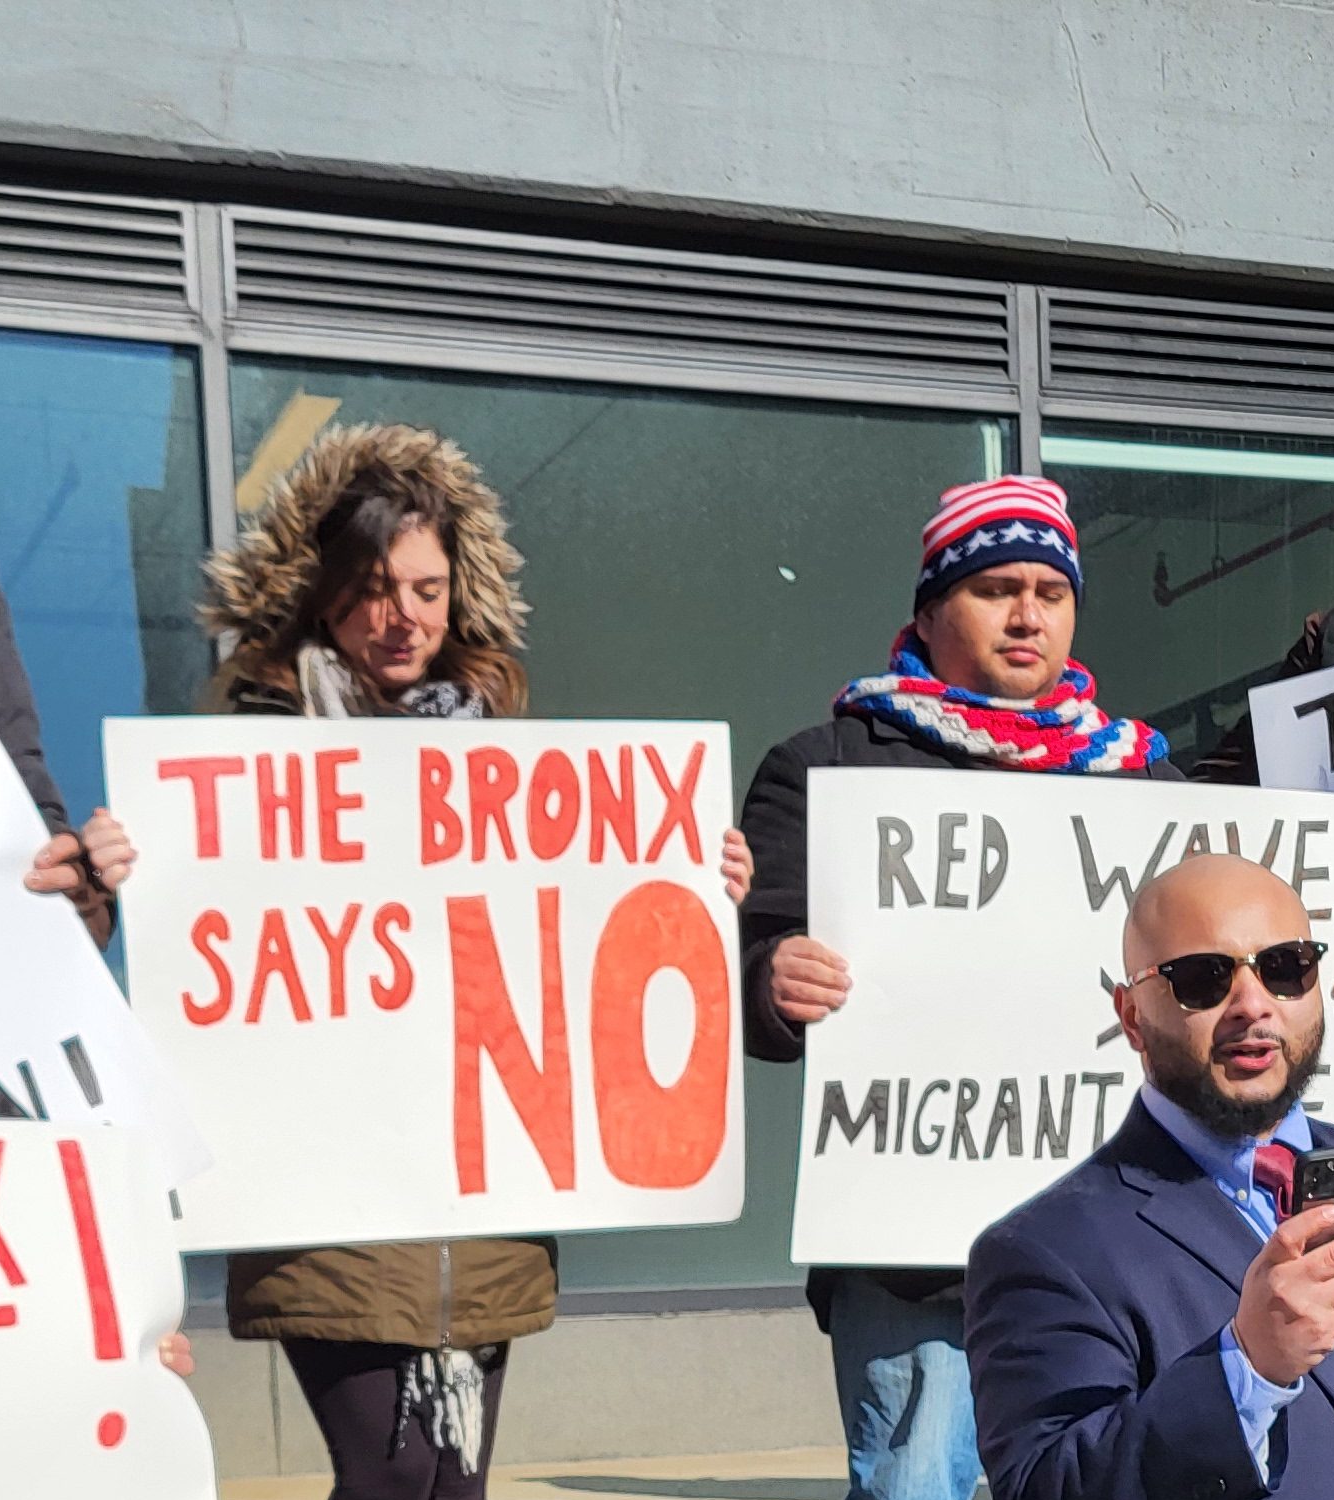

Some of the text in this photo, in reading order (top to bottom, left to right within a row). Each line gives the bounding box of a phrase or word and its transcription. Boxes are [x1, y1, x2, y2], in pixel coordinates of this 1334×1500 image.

[158, 741, 706, 866] THE BRONX
[877, 813, 1009, 910] RED
[181, 880, 731, 1196] SAYS NO
